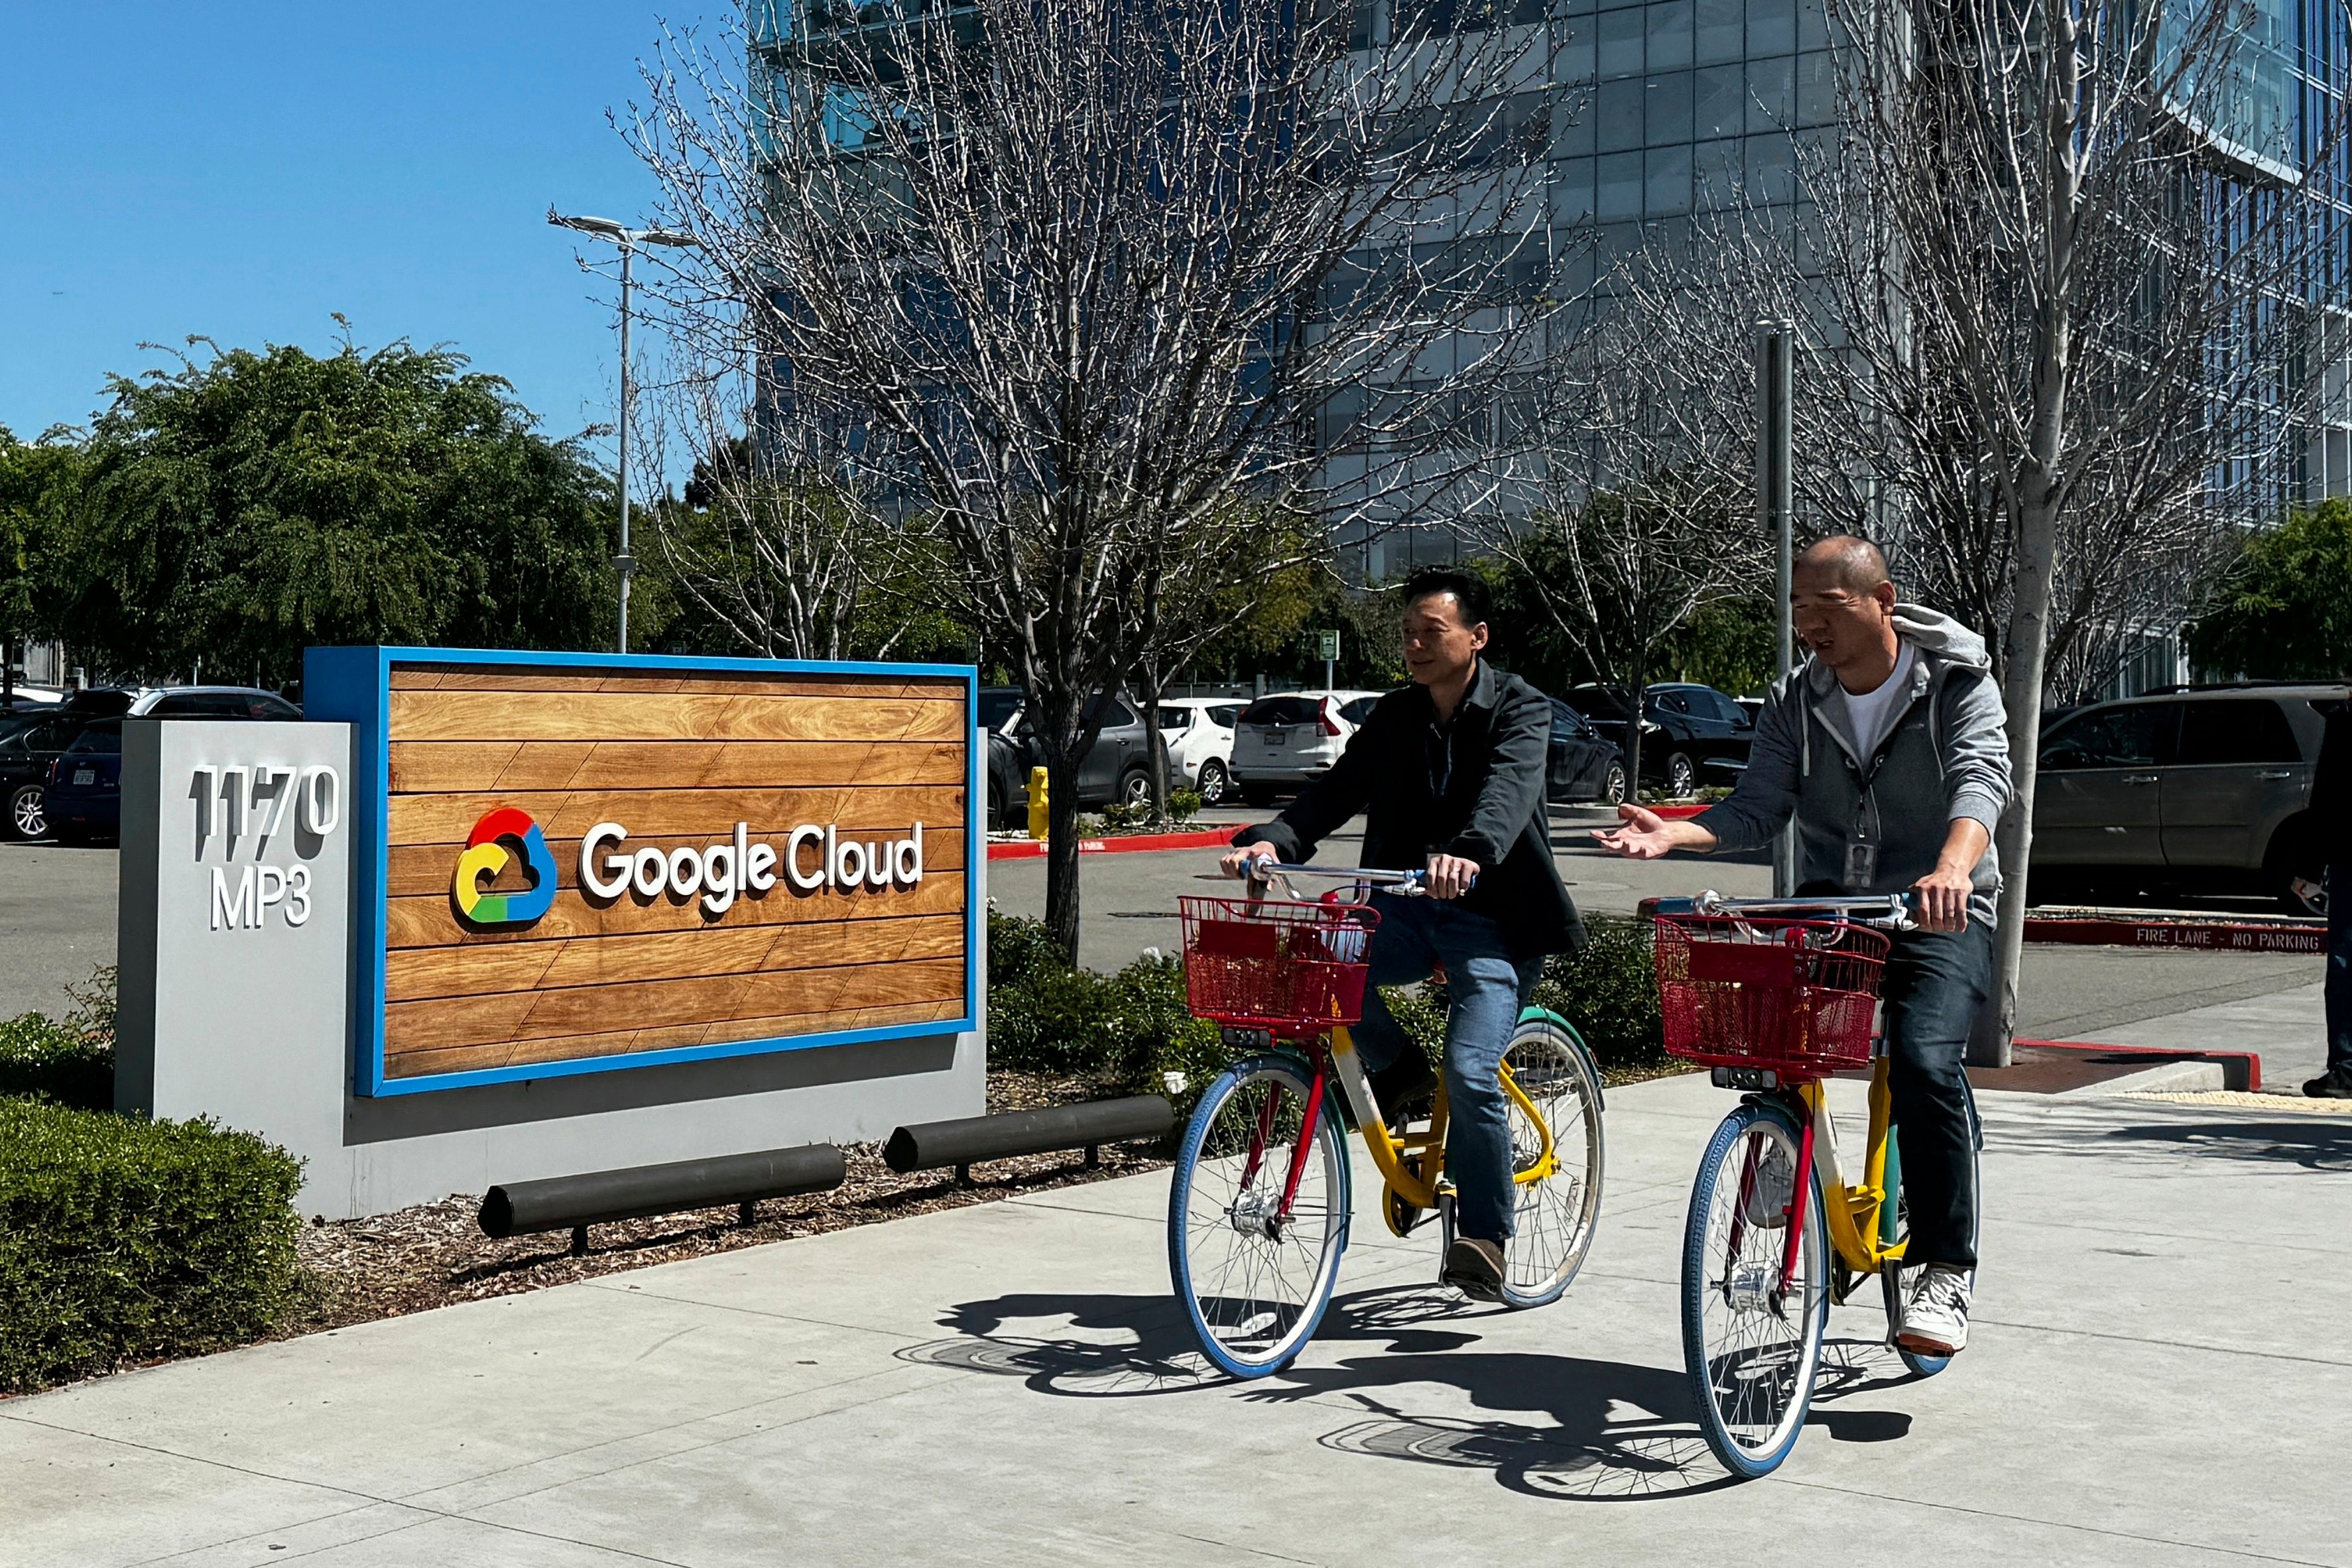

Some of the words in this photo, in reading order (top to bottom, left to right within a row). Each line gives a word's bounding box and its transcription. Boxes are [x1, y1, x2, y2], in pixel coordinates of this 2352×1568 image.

[192, 764, 340, 837] 1170
[211, 864, 312, 930] MP3
[580, 821, 778, 914] Google
[785, 821, 924, 889] Cloud
[2137, 928, 2168, 942] FIRE
[2175, 930, 2211, 944] LANE
[2233, 932, 2252, 947] NO
[2259, 933, 2319, 950] PARKING
